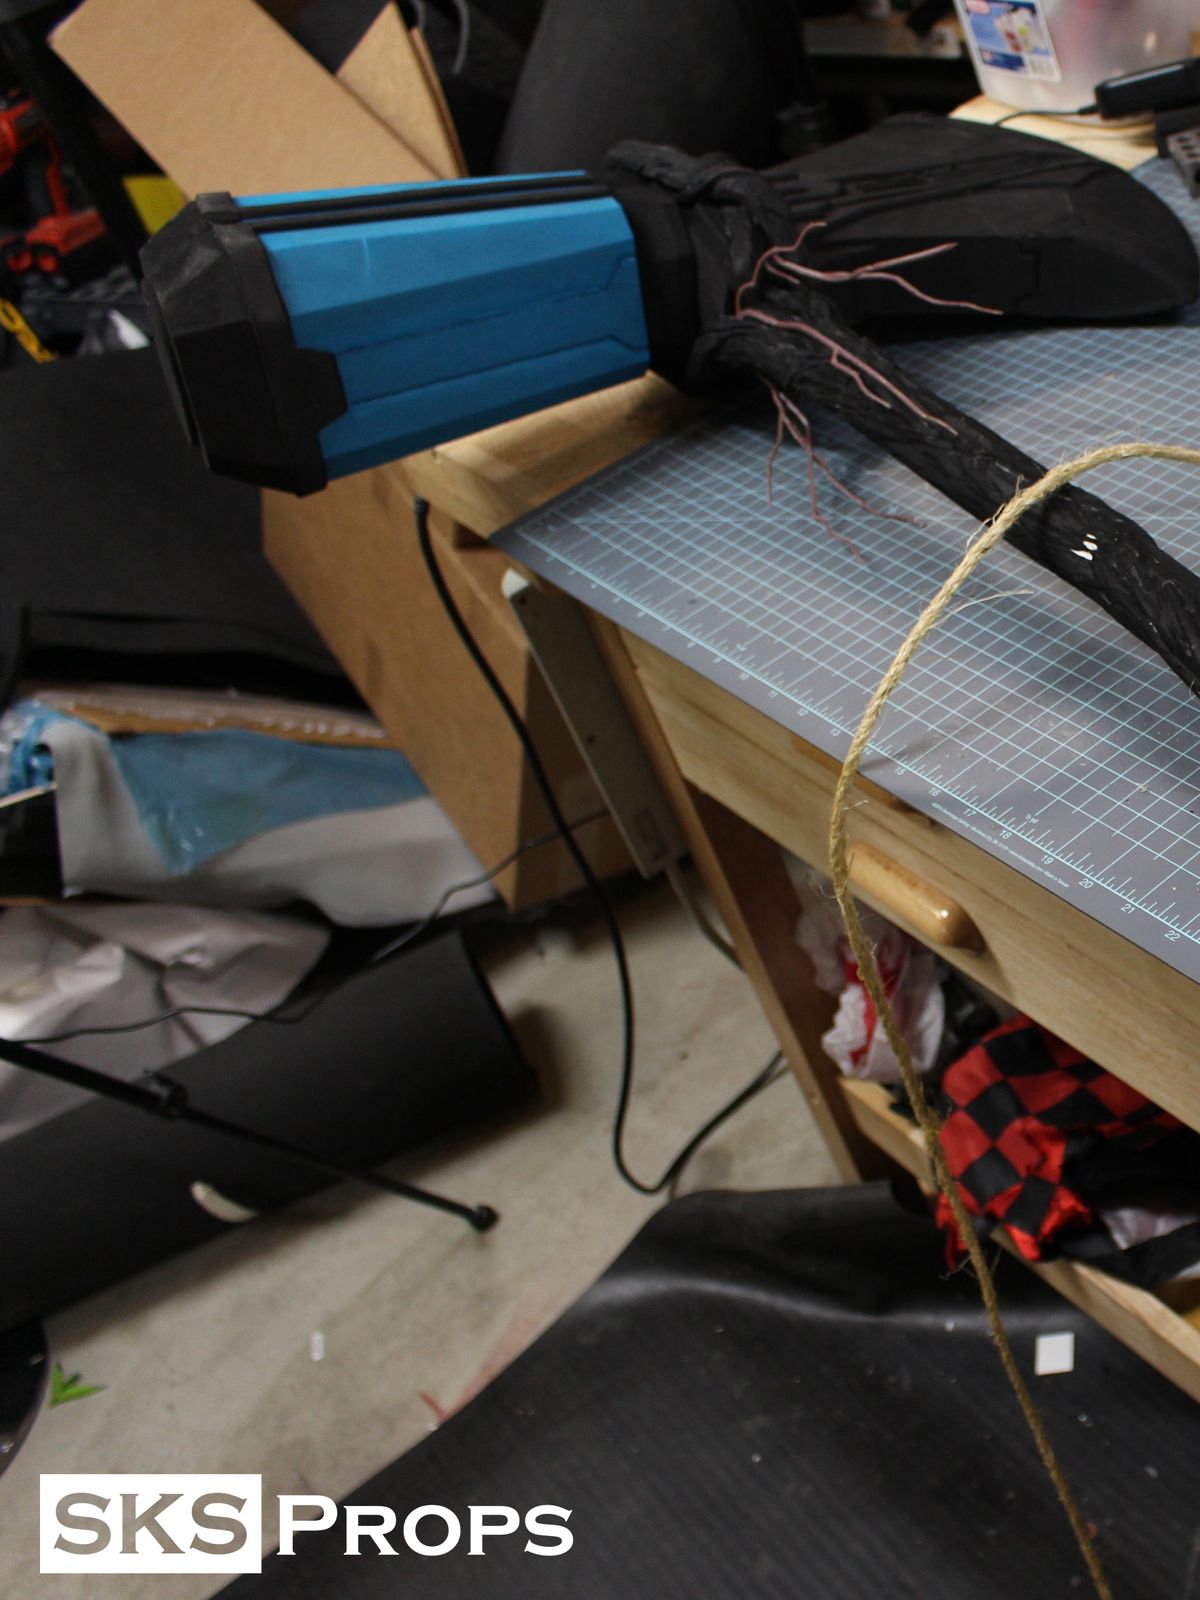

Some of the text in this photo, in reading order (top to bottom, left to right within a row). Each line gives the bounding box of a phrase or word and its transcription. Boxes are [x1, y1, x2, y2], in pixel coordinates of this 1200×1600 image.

[893, 766, 906, 776] 15
[928, 787, 941, 798] 16
[963, 808, 977, 818] 17
[1000, 829, 1012, 840] 18
[1041, 854, 1054, 865] 19
[1078, 877, 1094, 889] 20
[1120, 903, 1136, 915] 21
[1164, 929, 1181, 942] 22
